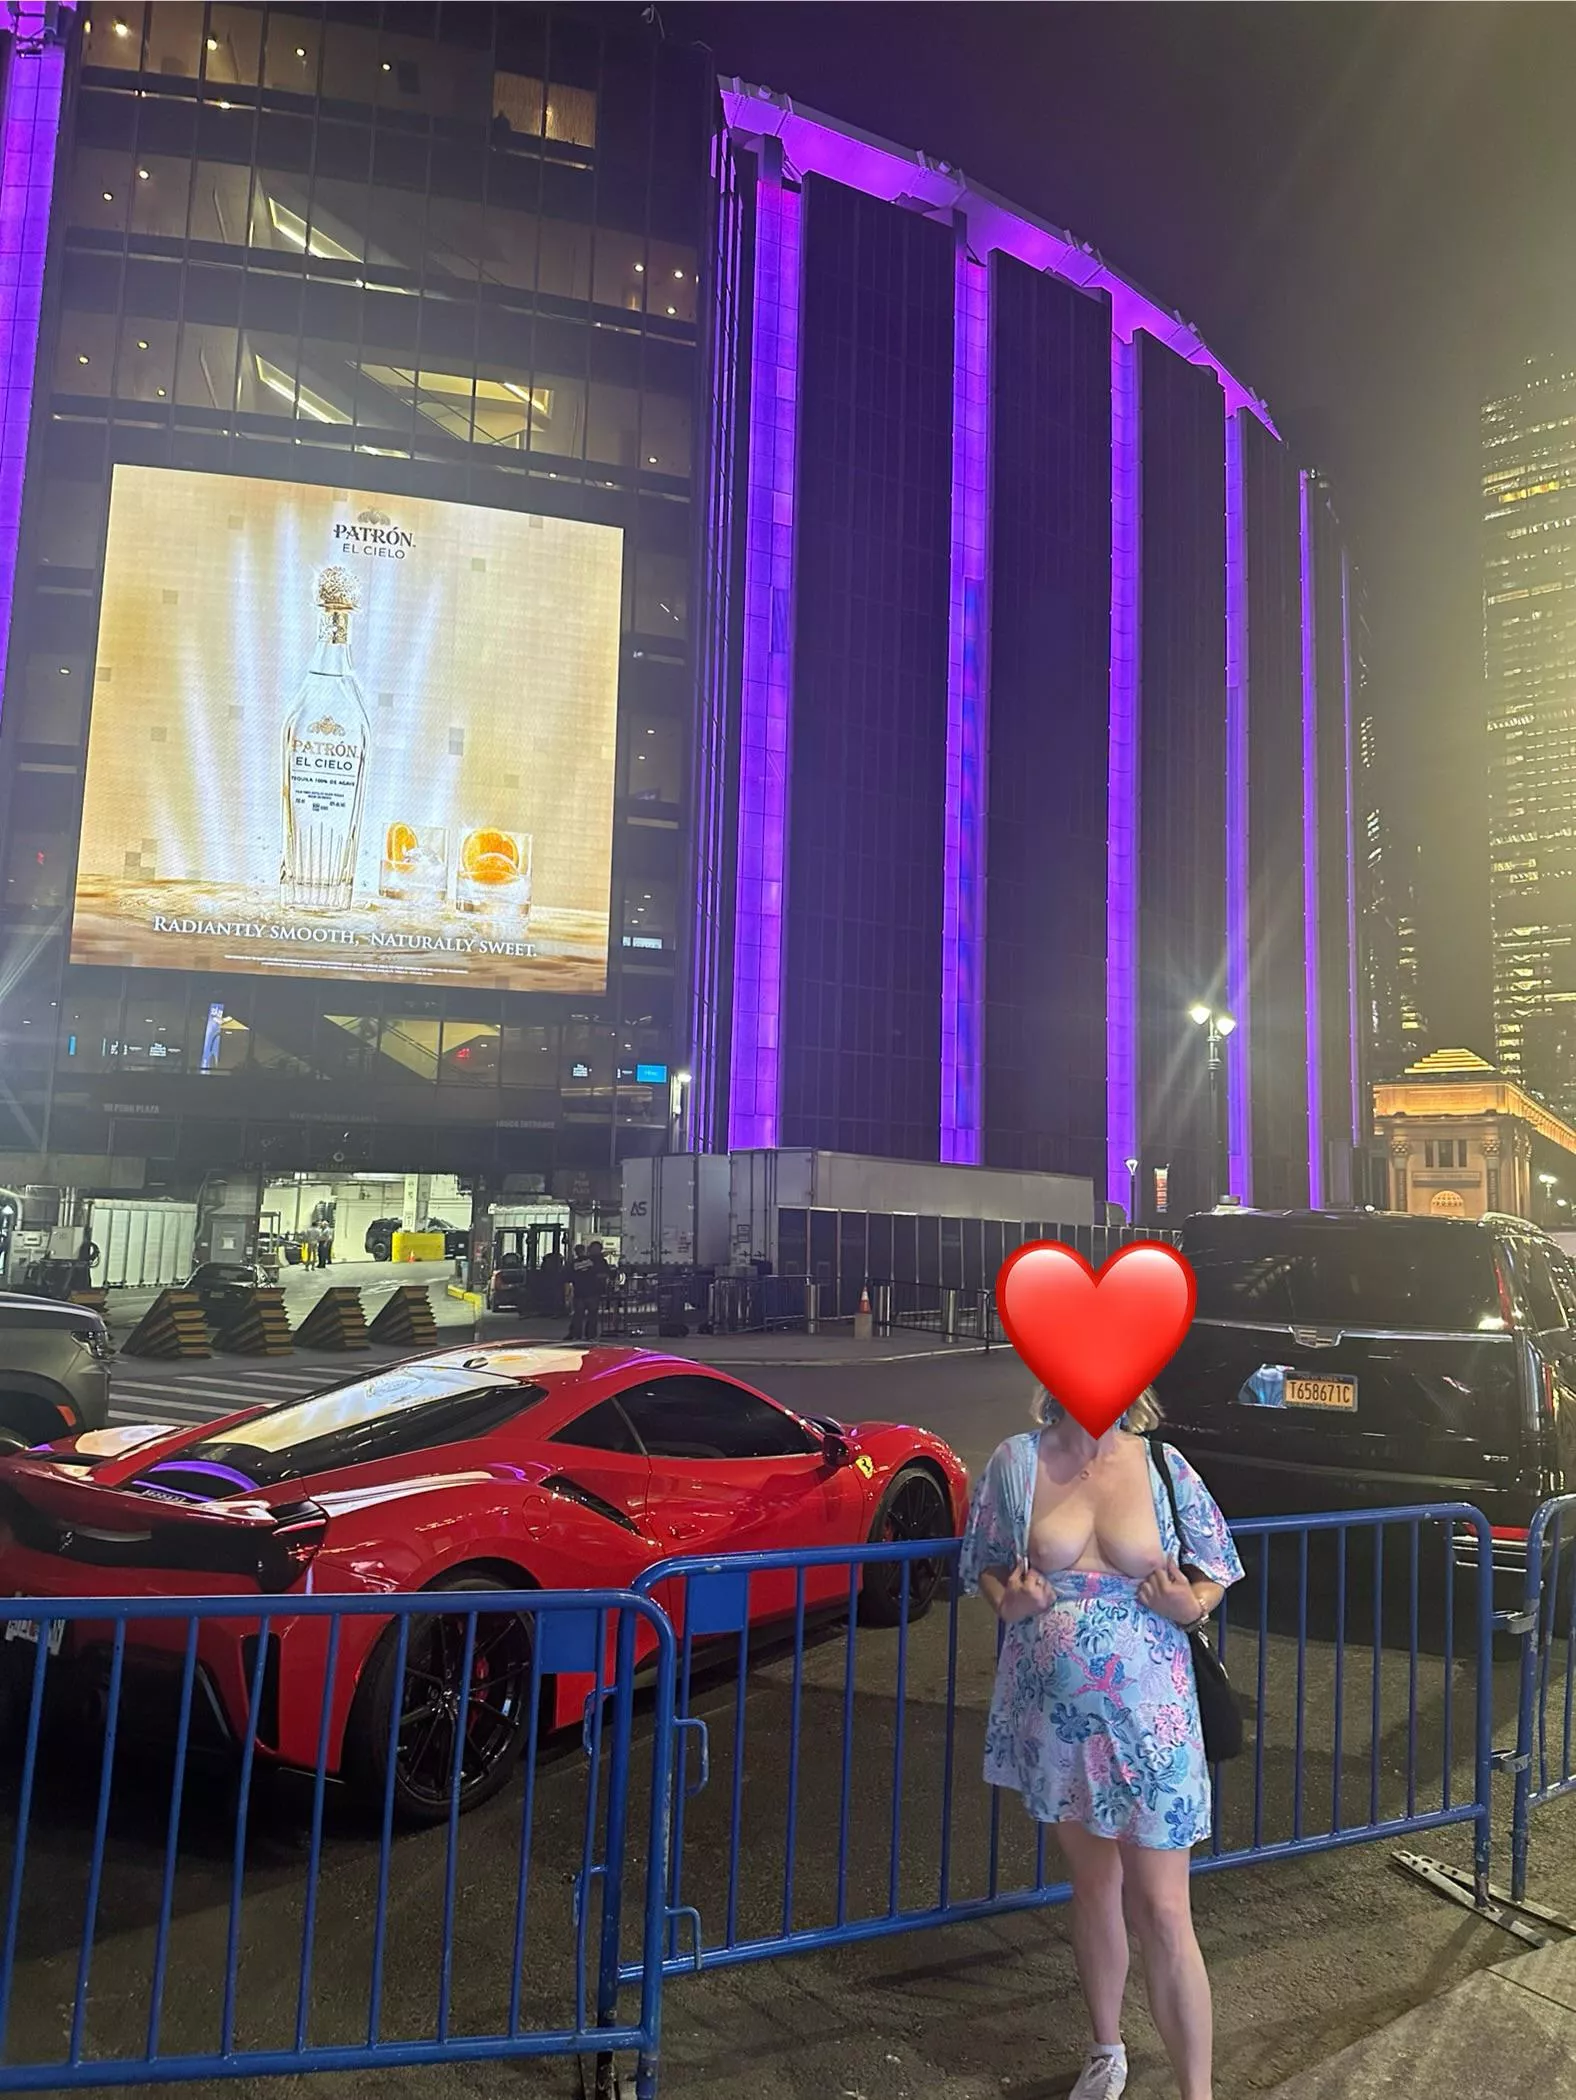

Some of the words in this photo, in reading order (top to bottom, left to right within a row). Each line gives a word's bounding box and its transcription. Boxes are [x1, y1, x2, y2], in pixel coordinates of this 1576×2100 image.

[333, 524, 413, 548] PATRÓN
[342, 543, 359, 554] EL
[363, 546, 405, 559] CIELO
[292, 739, 357, 758] PATRÓN
[295, 757, 311, 767] EL
[314, 759, 353, 770] CIELO
[153, 915, 267, 938] RADIANTLY
[269, 925, 359, 946] SMOOTH,
[369, 932, 476, 953] NATURALLY
[1289, 1382, 1350, 1403] T658671C
